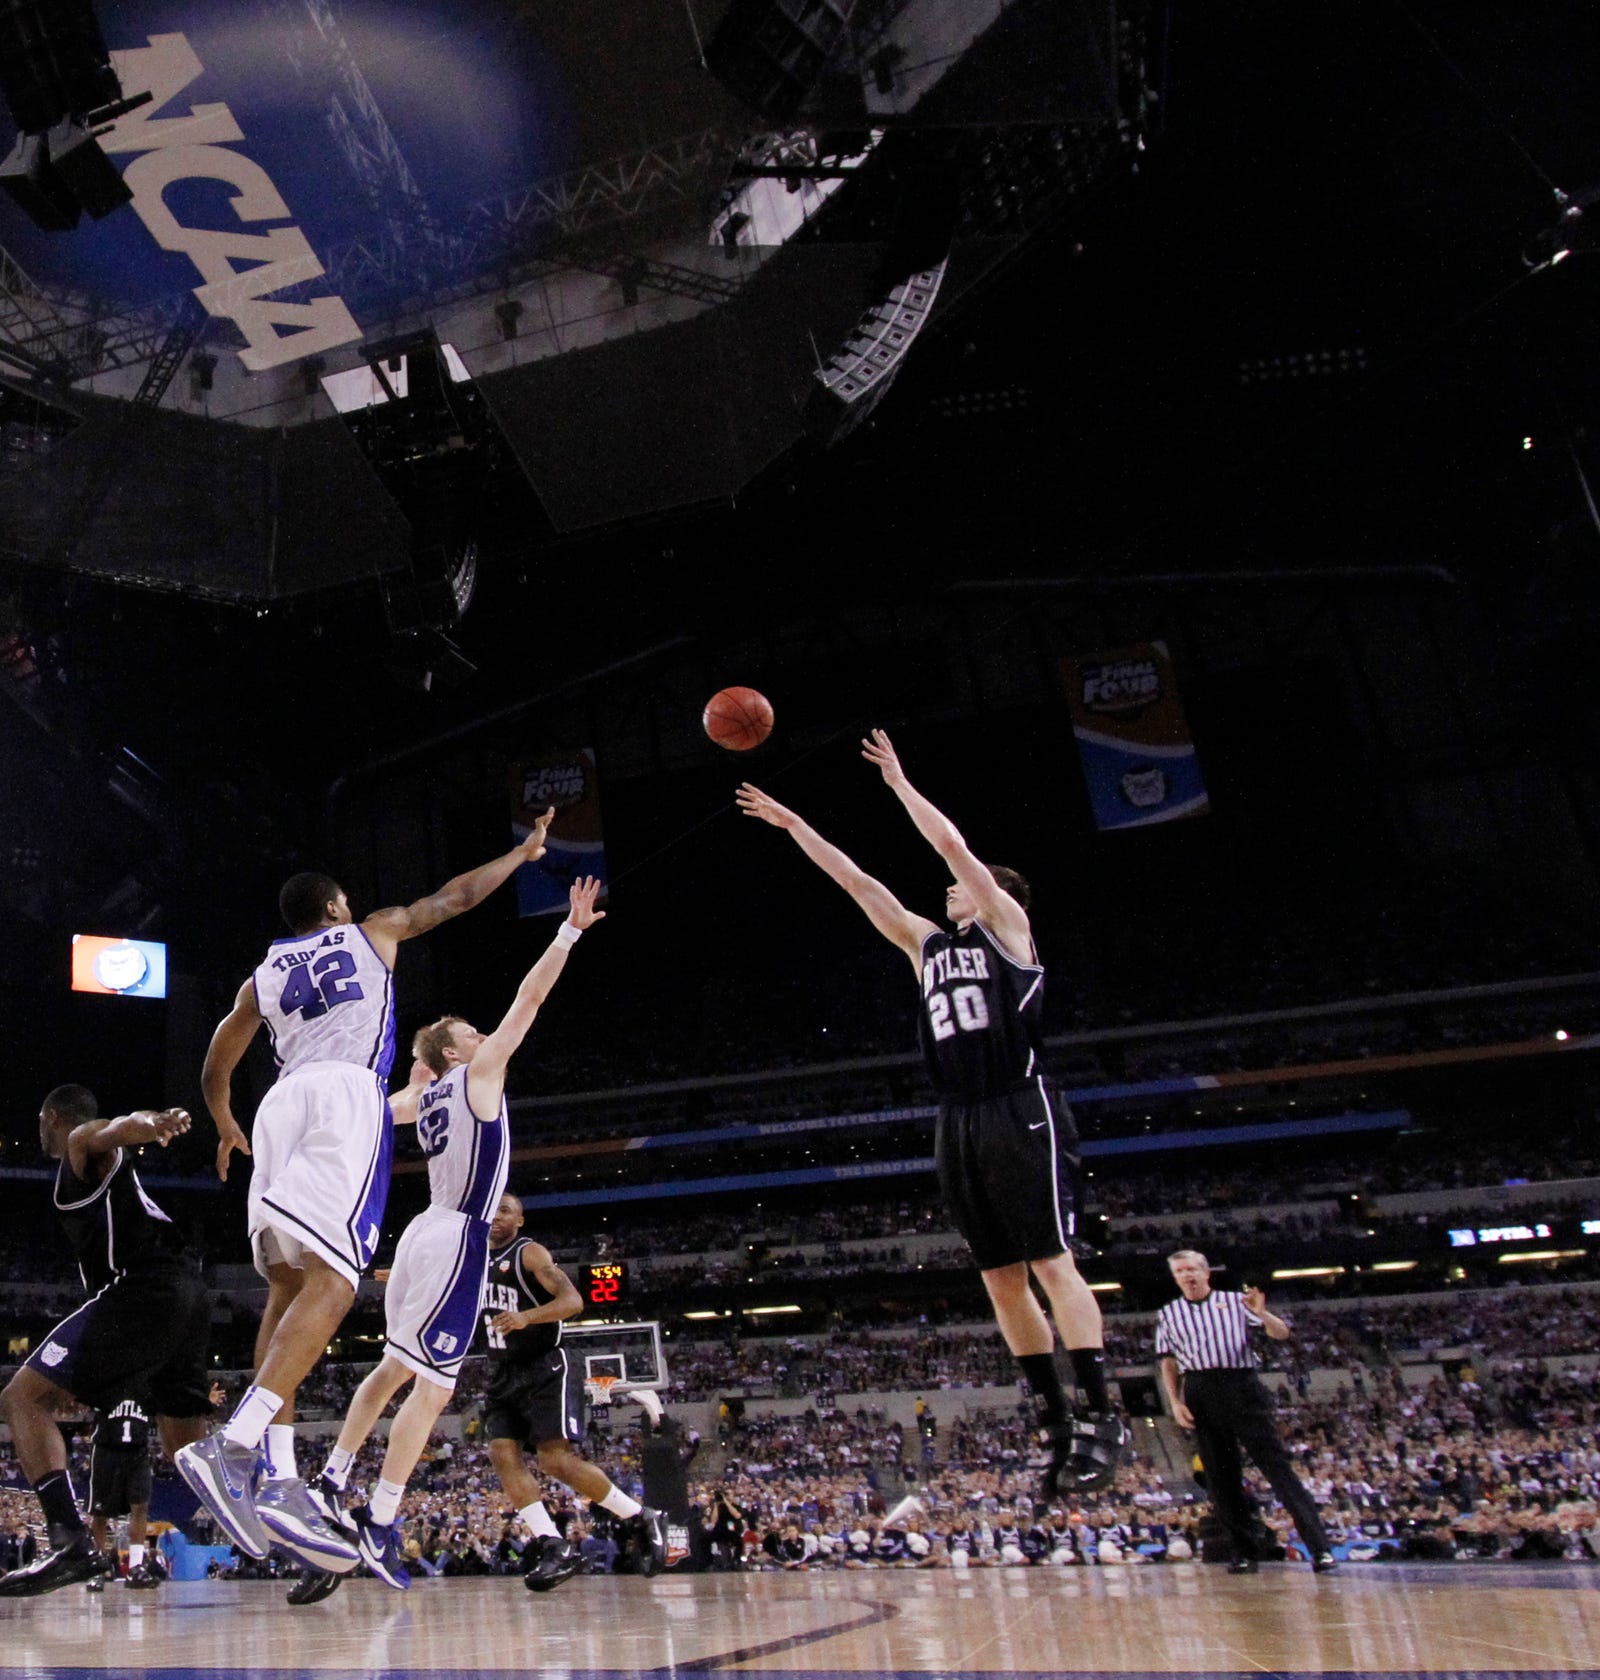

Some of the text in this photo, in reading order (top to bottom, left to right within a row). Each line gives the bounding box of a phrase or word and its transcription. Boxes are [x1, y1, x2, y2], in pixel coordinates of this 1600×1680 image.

[90, 31, 364, 371] NCAA
[1083, 674, 1160, 704] FOUR
[523, 777, 585, 803] FOUR
[272, 931, 345, 973] THOAS
[279, 950, 364, 1021] 42
[929, 985, 990, 1042] 20
[758, 1118, 827, 1135] WELCOME
[830, 1116, 848, 1128] TO
[848, 1112, 878, 1126] THE
[834, 1166, 862, 1179] THE
[591, 1265, 622, 1279] 4:54
[590, 1278, 620, 1302] 22
[121, 1420, 132, 1442] 1
